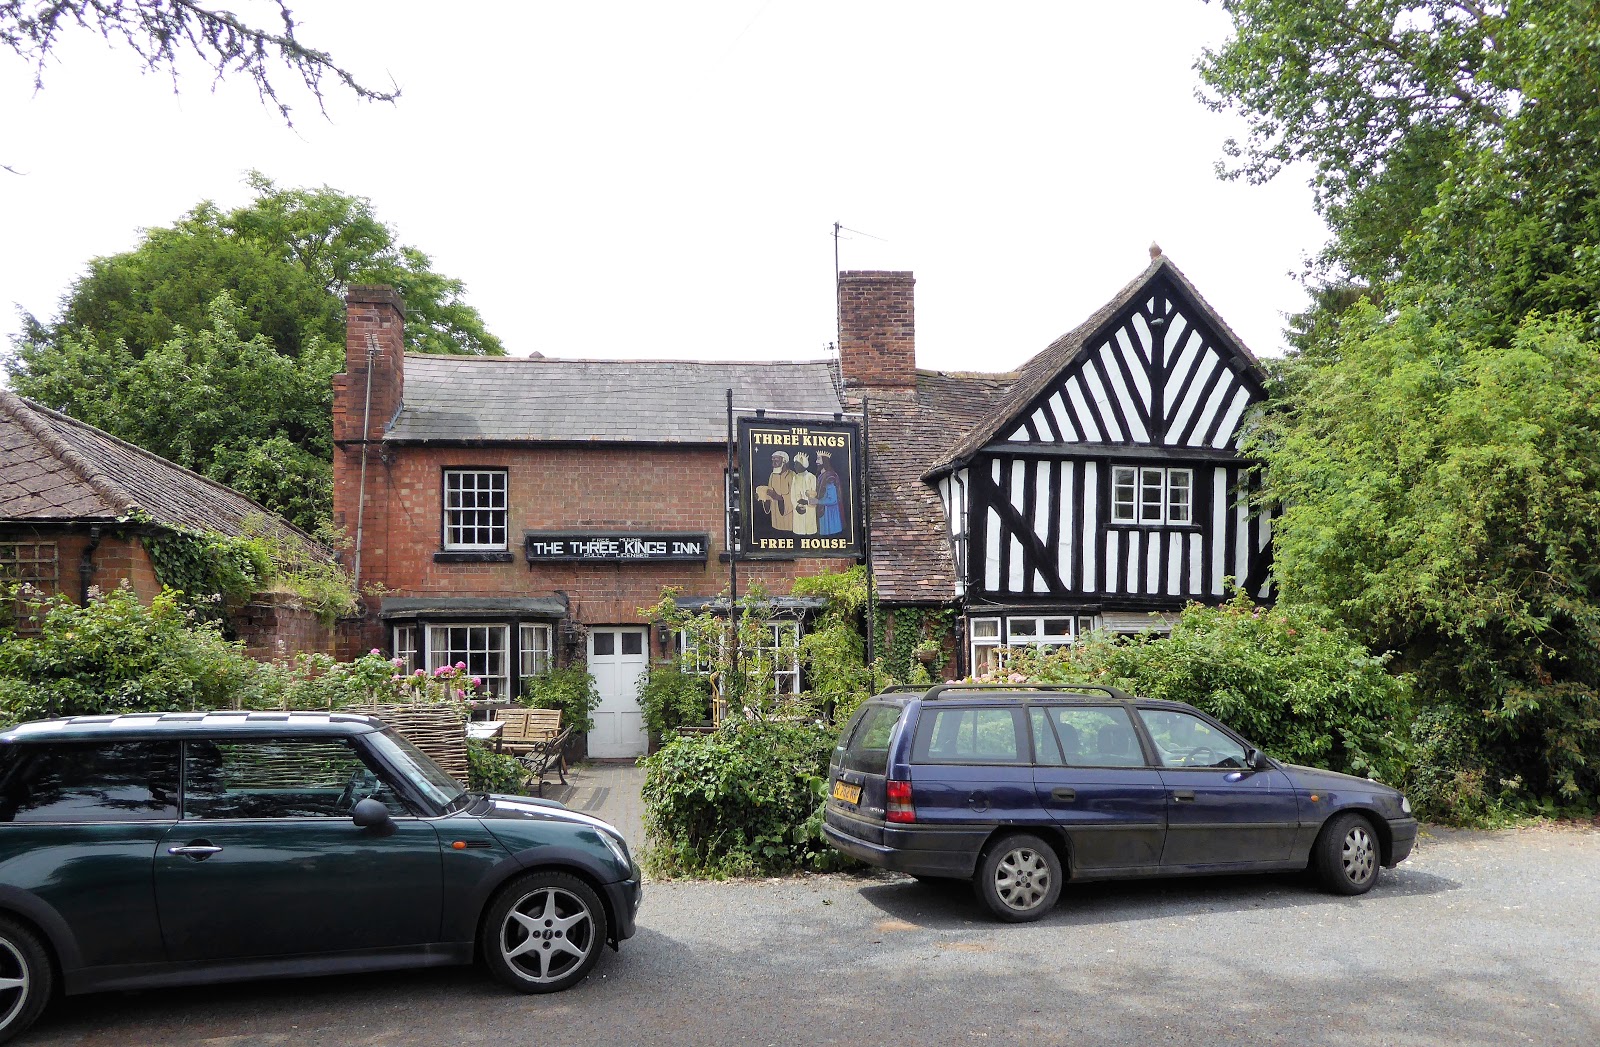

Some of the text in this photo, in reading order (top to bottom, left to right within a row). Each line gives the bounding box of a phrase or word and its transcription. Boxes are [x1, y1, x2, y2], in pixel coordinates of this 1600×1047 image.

[754, 433, 845, 447] THREE KINGS
[533, 541, 700, 555] THE THREE KINGS INN
[760, 538, 847, 549] FREE HOUSE
